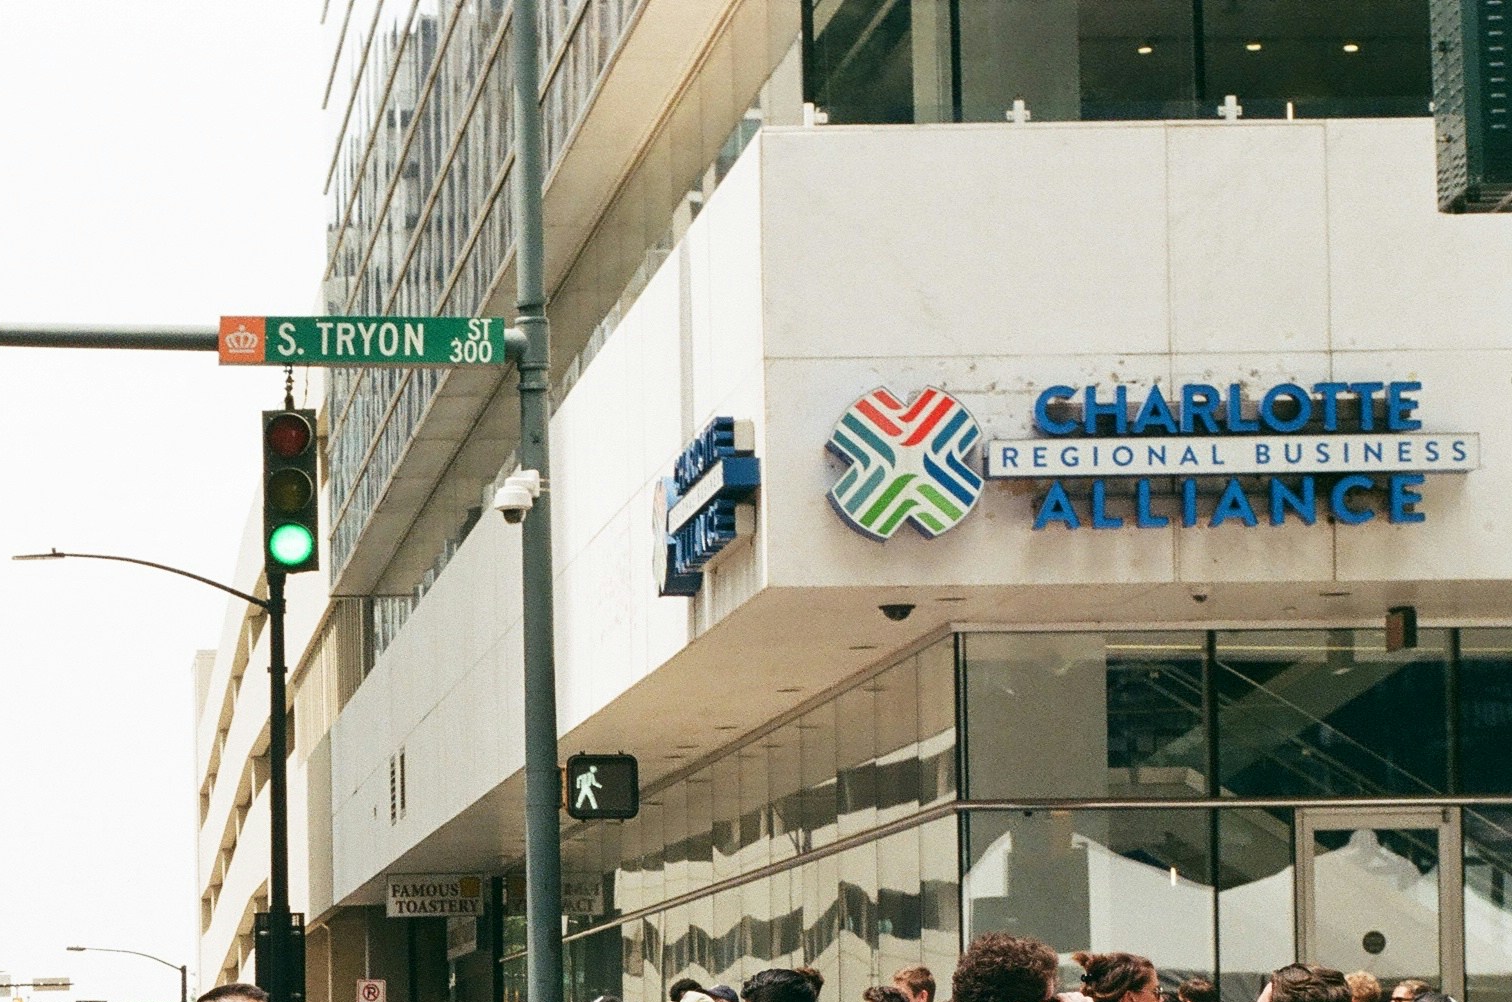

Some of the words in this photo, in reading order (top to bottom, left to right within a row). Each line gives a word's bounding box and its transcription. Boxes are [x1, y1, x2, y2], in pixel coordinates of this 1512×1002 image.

[278, 323, 304, 356] S.
[317, 322, 424, 357] TRYON
[467, 319, 492, 341] ST
[449, 340, 492, 363] 300
[1034, 381, 1423, 435] CHARLOTTE
[1002, 444, 1225, 468] REGIONAL
[1255, 440, 1467, 465] BUSINESS
[1032, 474, 1426, 531] ALLIANCE
[391, 883, 459, 898] FAMOUS
[395, 899, 478, 914] TOASTERY
